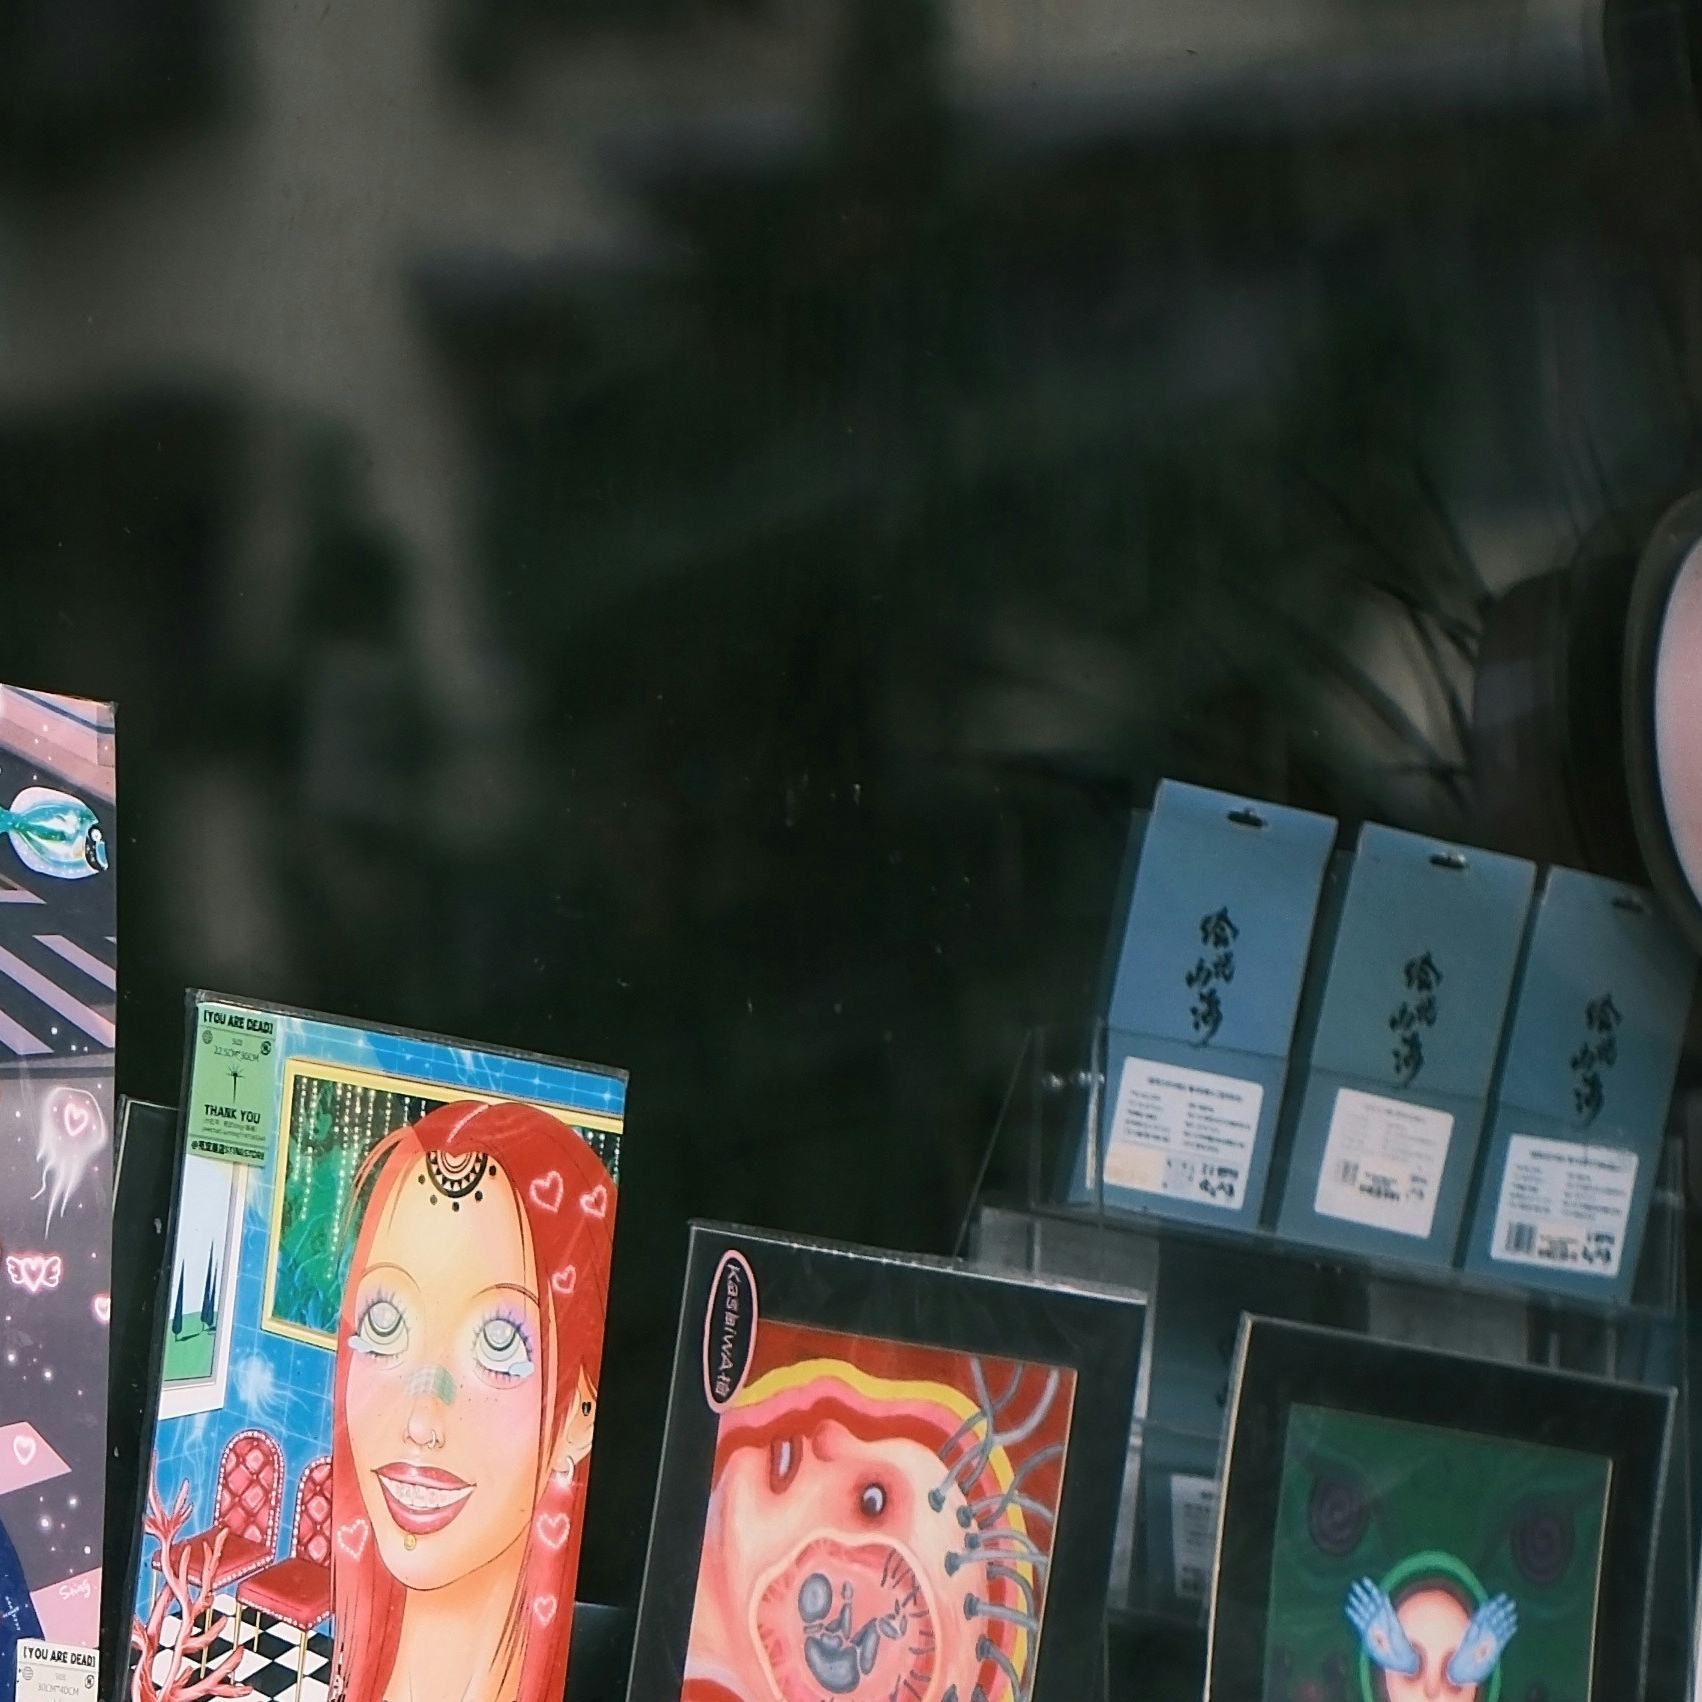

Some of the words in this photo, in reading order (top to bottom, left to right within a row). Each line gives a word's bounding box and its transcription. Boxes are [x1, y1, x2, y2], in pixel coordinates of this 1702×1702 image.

[227, 1015, 245, 1029] ARE
[204, 1104, 237, 1119] THANK
[240, 1110, 261, 1124] YOU
[50, 1650, 67, 1664] ARE
